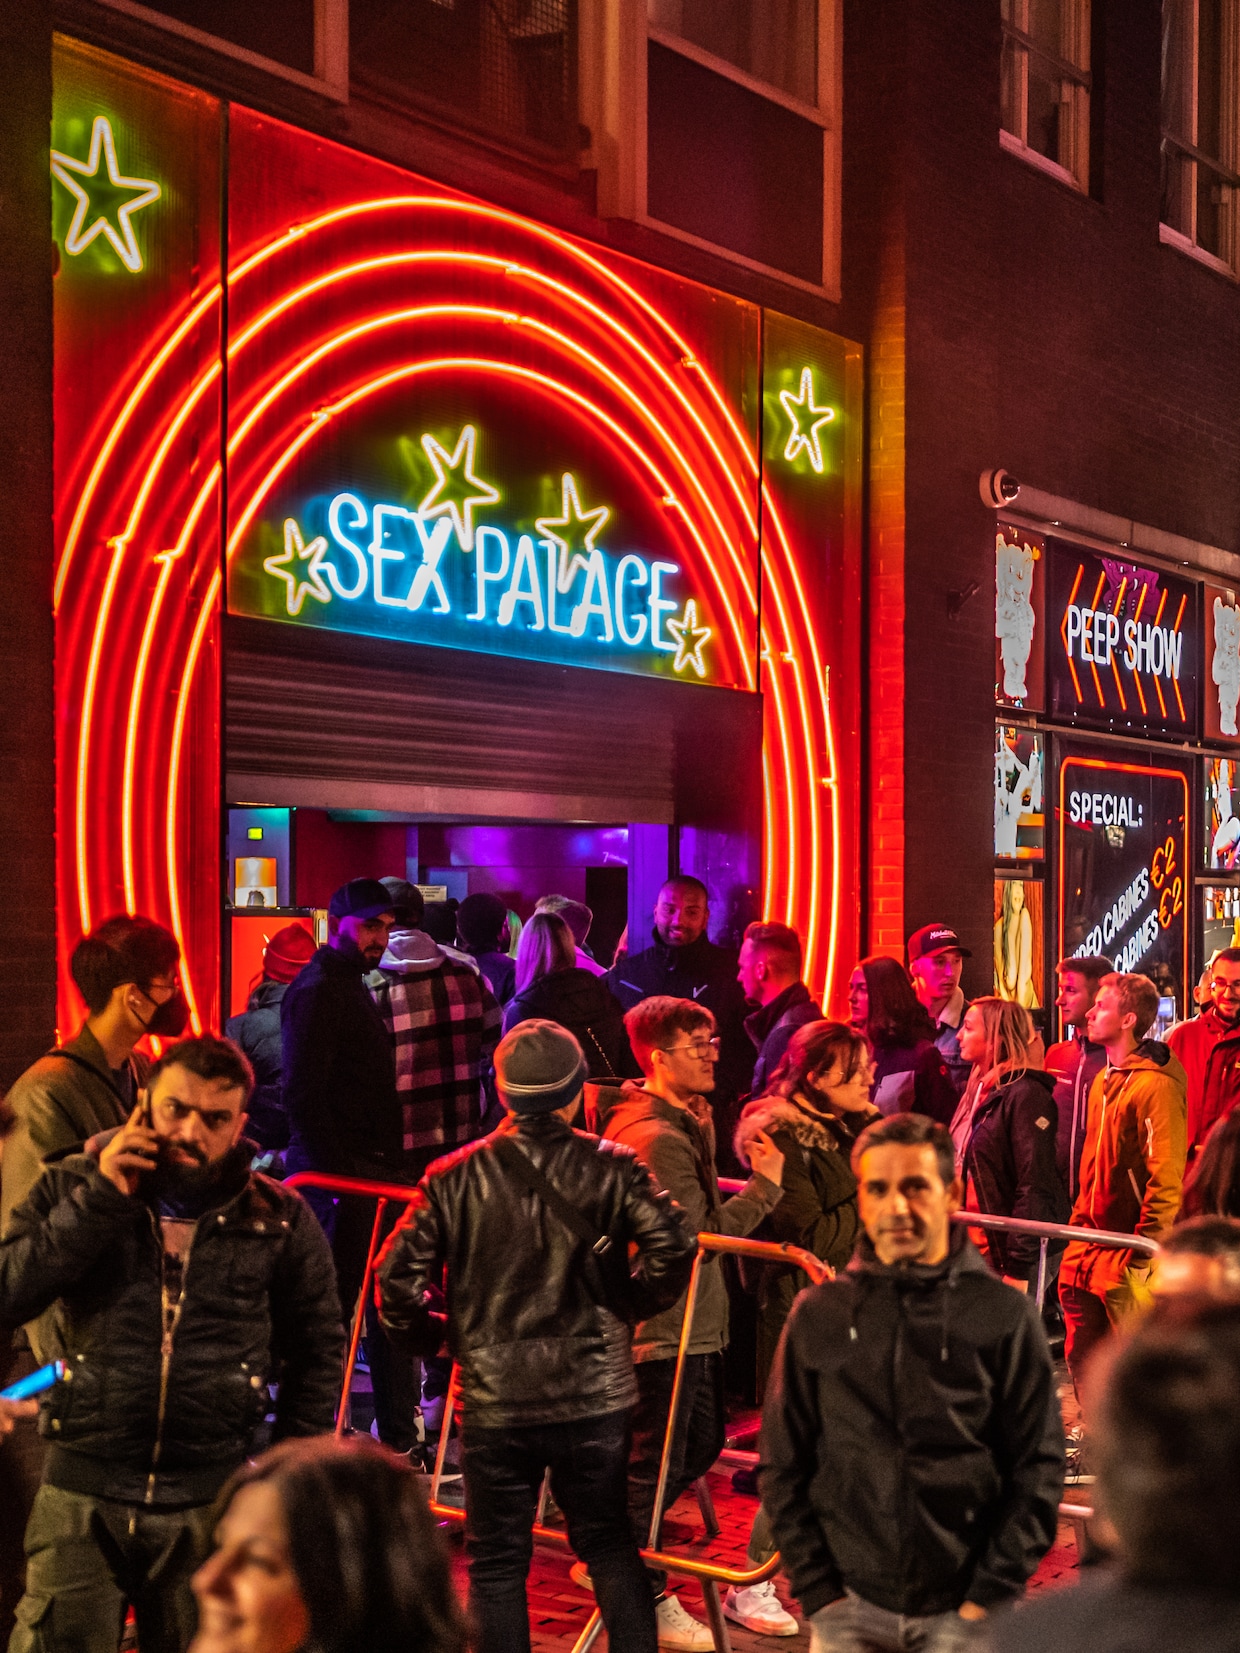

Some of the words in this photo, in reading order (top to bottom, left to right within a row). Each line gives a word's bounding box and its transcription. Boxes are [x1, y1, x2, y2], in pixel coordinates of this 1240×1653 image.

[316, 492, 453, 614] SEX
[467, 525, 679, 651] PALACE
[1067, 604, 1120, 666] PEEP
[1123, 618, 1183, 680] SHOW
[1070, 791, 1142, 827] SPECIAL:
[1103, 867, 1150, 946] CABINES
[1151, 837, 1176, 887] €2
[1114, 909, 1158, 975] CABINES
[1159, 877, 1182, 928] €2
